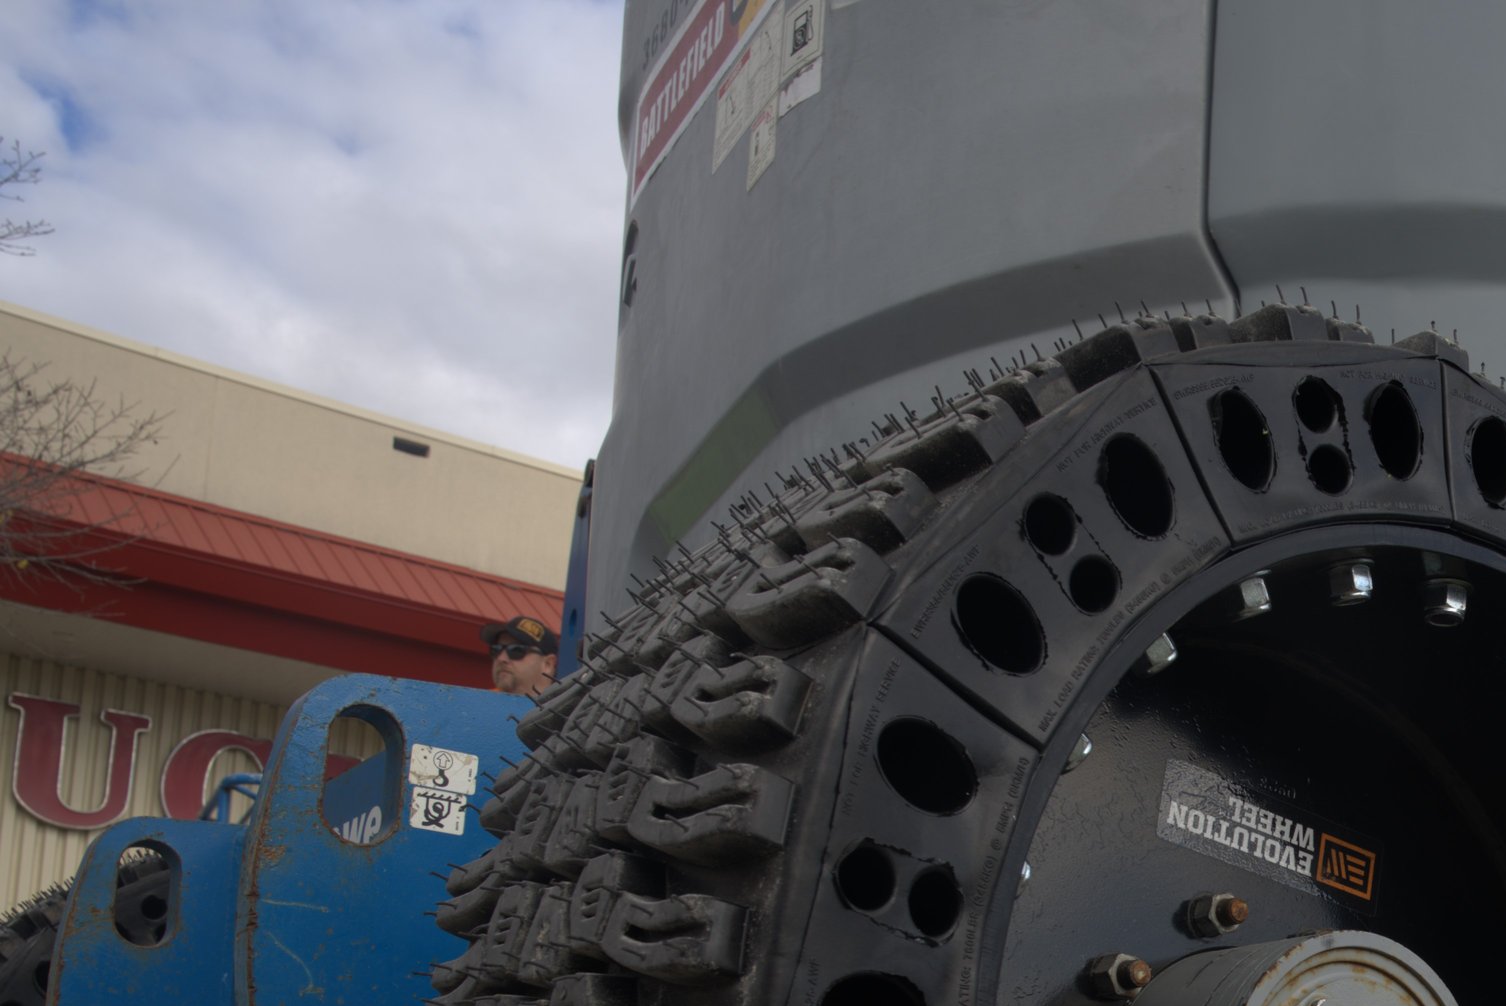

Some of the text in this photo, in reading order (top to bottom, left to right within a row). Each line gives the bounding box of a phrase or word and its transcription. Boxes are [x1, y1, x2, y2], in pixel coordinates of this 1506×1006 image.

[640, 2, 725, 160] BATTLEFIELD
[1167, 801, 1313, 877] EVOLUTION
[1228, 797, 1315, 851] WHEEL
